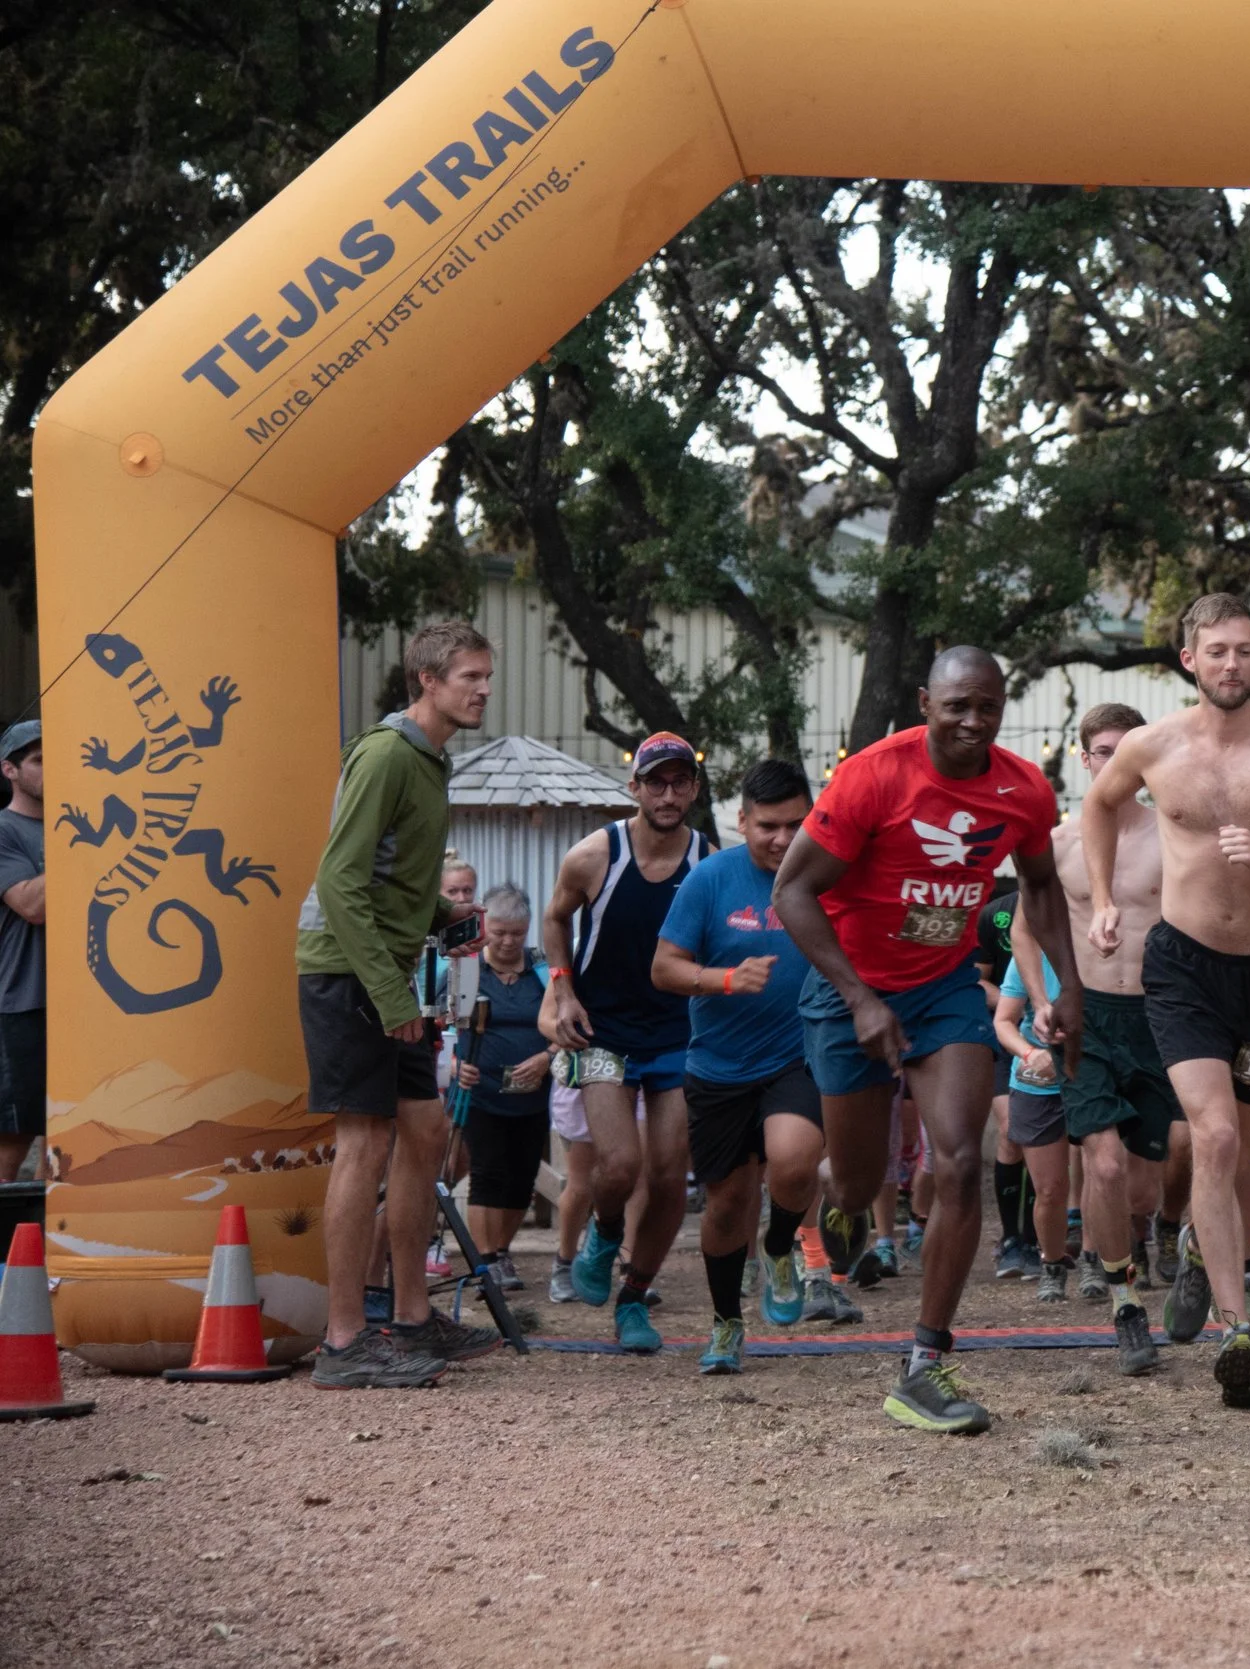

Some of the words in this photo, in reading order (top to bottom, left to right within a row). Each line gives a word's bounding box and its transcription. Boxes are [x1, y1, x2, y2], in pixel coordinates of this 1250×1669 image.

[181, 219, 396, 399] TEJAS
[384, 26, 615, 225] TRAILS
[244, 387, 312, 446] More
[310, 337, 372, 389] than
[366, 292, 423, 346] just
[420, 246, 475, 305] trail
[475, 159, 586, 256] running...
[127, 662, 204, 774] TEJAS
[94, 783, 202, 906] TRAILS
[901, 878, 984, 907] RWB
[913, 919, 958, 939] 193
[583, 1058, 617, 1077] 198
